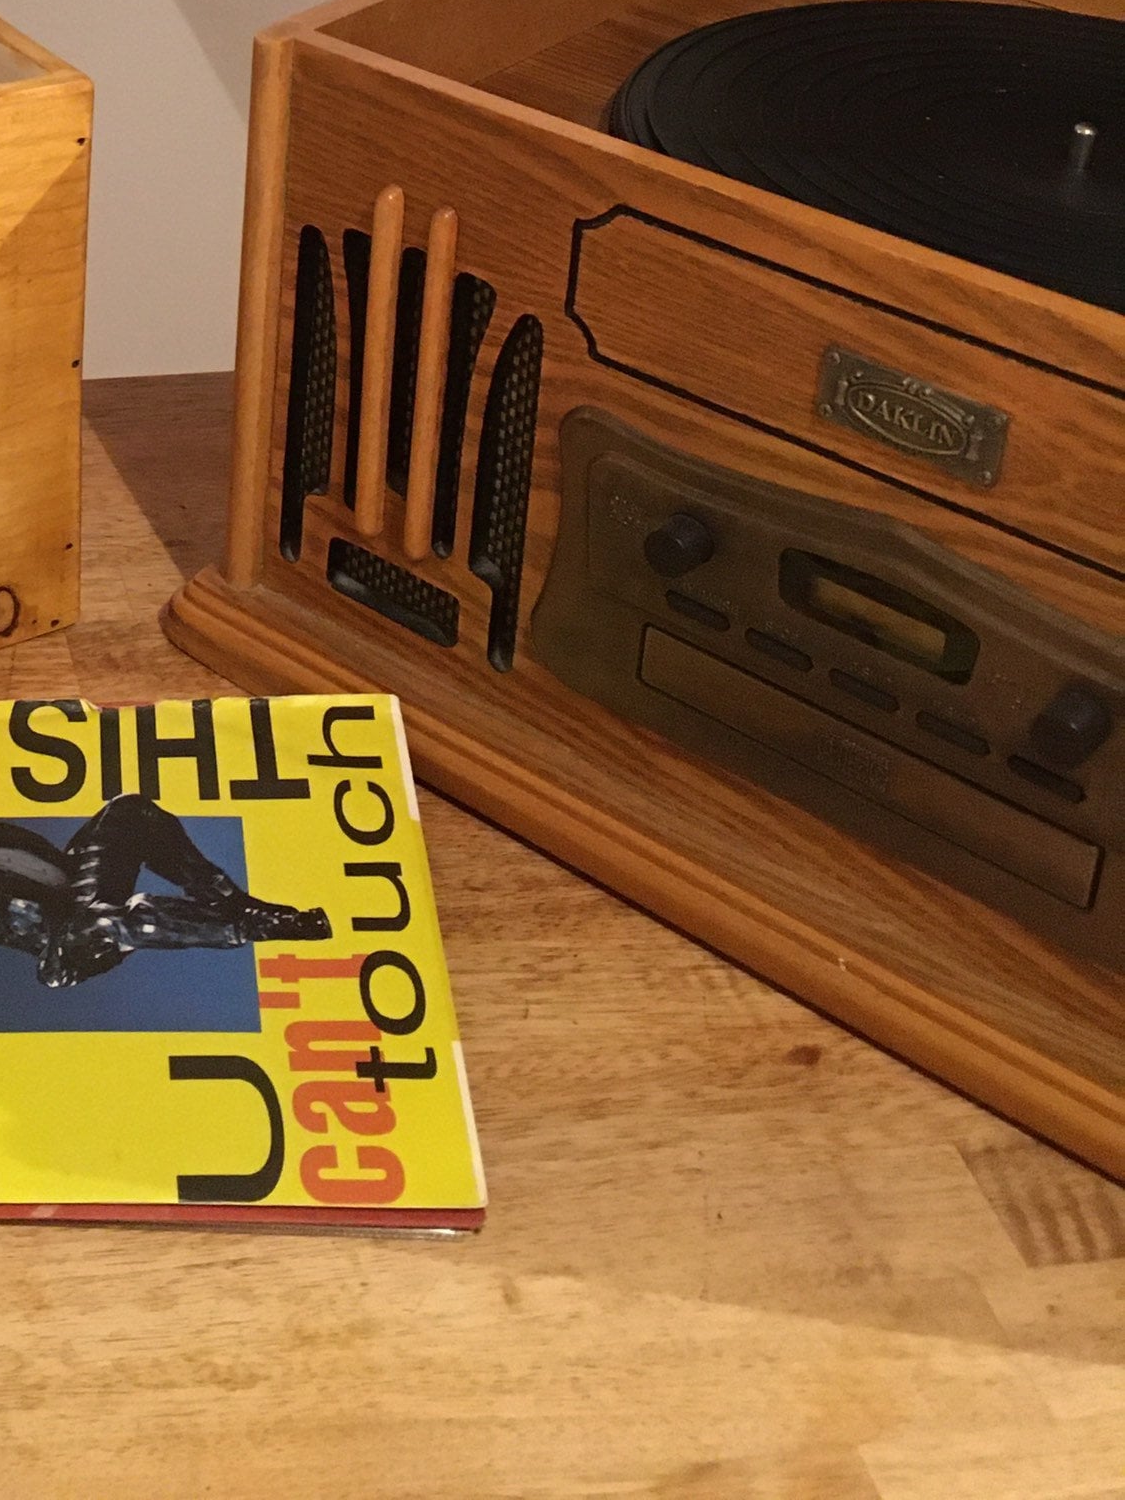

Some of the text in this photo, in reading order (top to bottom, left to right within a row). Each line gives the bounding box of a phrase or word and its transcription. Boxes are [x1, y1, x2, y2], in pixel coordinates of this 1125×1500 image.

[855, 390, 954, 447] DAKLIN
[9, 698, 310, 802] THIS
[307, 706, 437, 1093] touch
[168, 1055, 285, 1204] U
[258, 954, 405, 1204] can't
